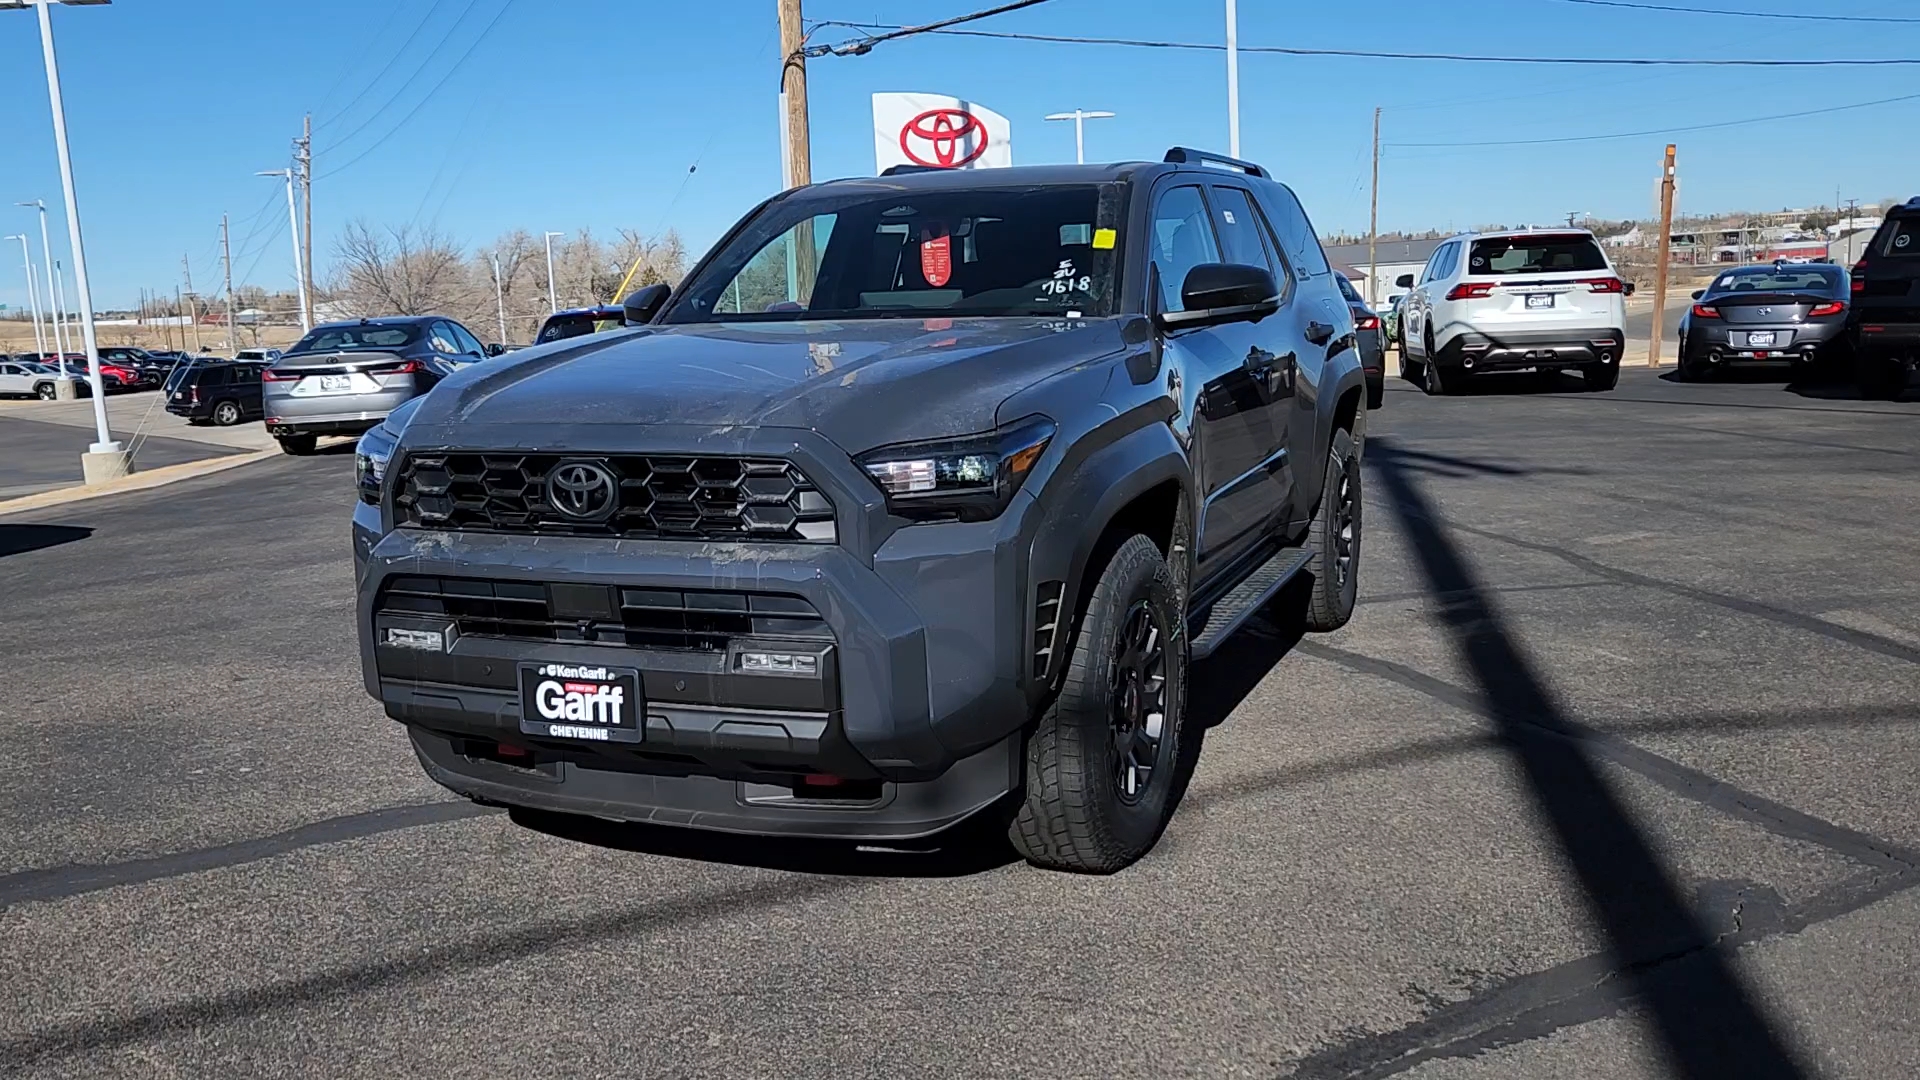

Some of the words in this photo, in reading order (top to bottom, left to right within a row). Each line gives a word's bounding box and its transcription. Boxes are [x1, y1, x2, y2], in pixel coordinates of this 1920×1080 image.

[1042, 276, 1091, 295] 7618
[1528, 297, 1552, 306] Garff
[1748, 334, 1775, 344] Garff
[536, 680, 623, 724] Garff
[549, 725, 608, 740] CHEYENNE
